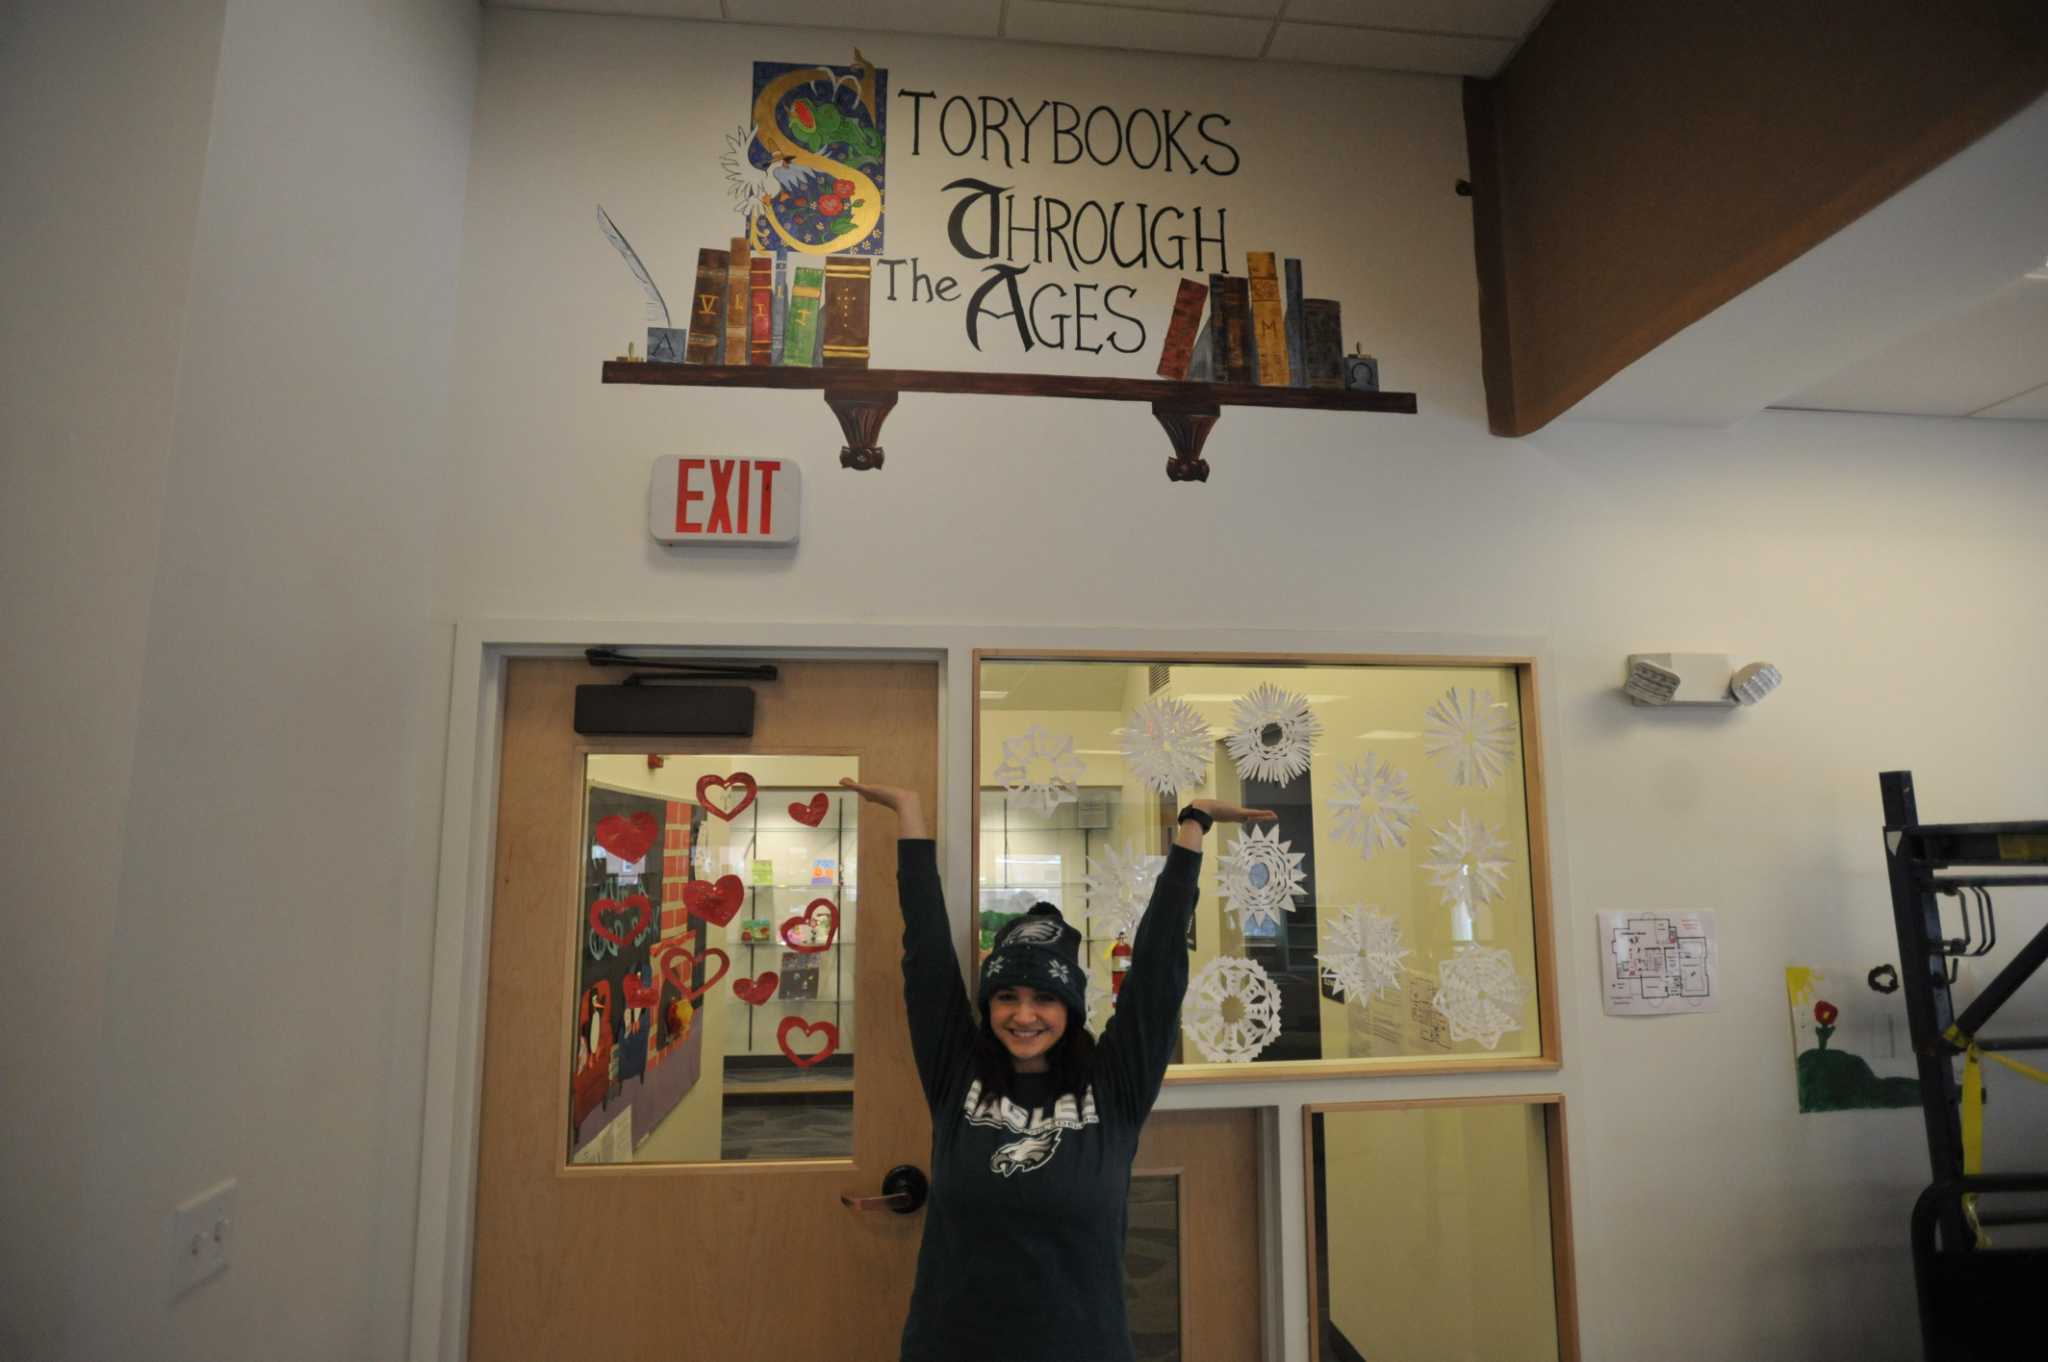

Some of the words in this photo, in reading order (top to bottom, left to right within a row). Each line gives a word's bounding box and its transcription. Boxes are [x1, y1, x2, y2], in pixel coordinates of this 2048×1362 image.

[941, 177, 1230, 273] THROUGH
[877, 258, 960, 302] The
[966, 263, 1146, 353] AGES
[675, 459, 781, 534] EXIT
